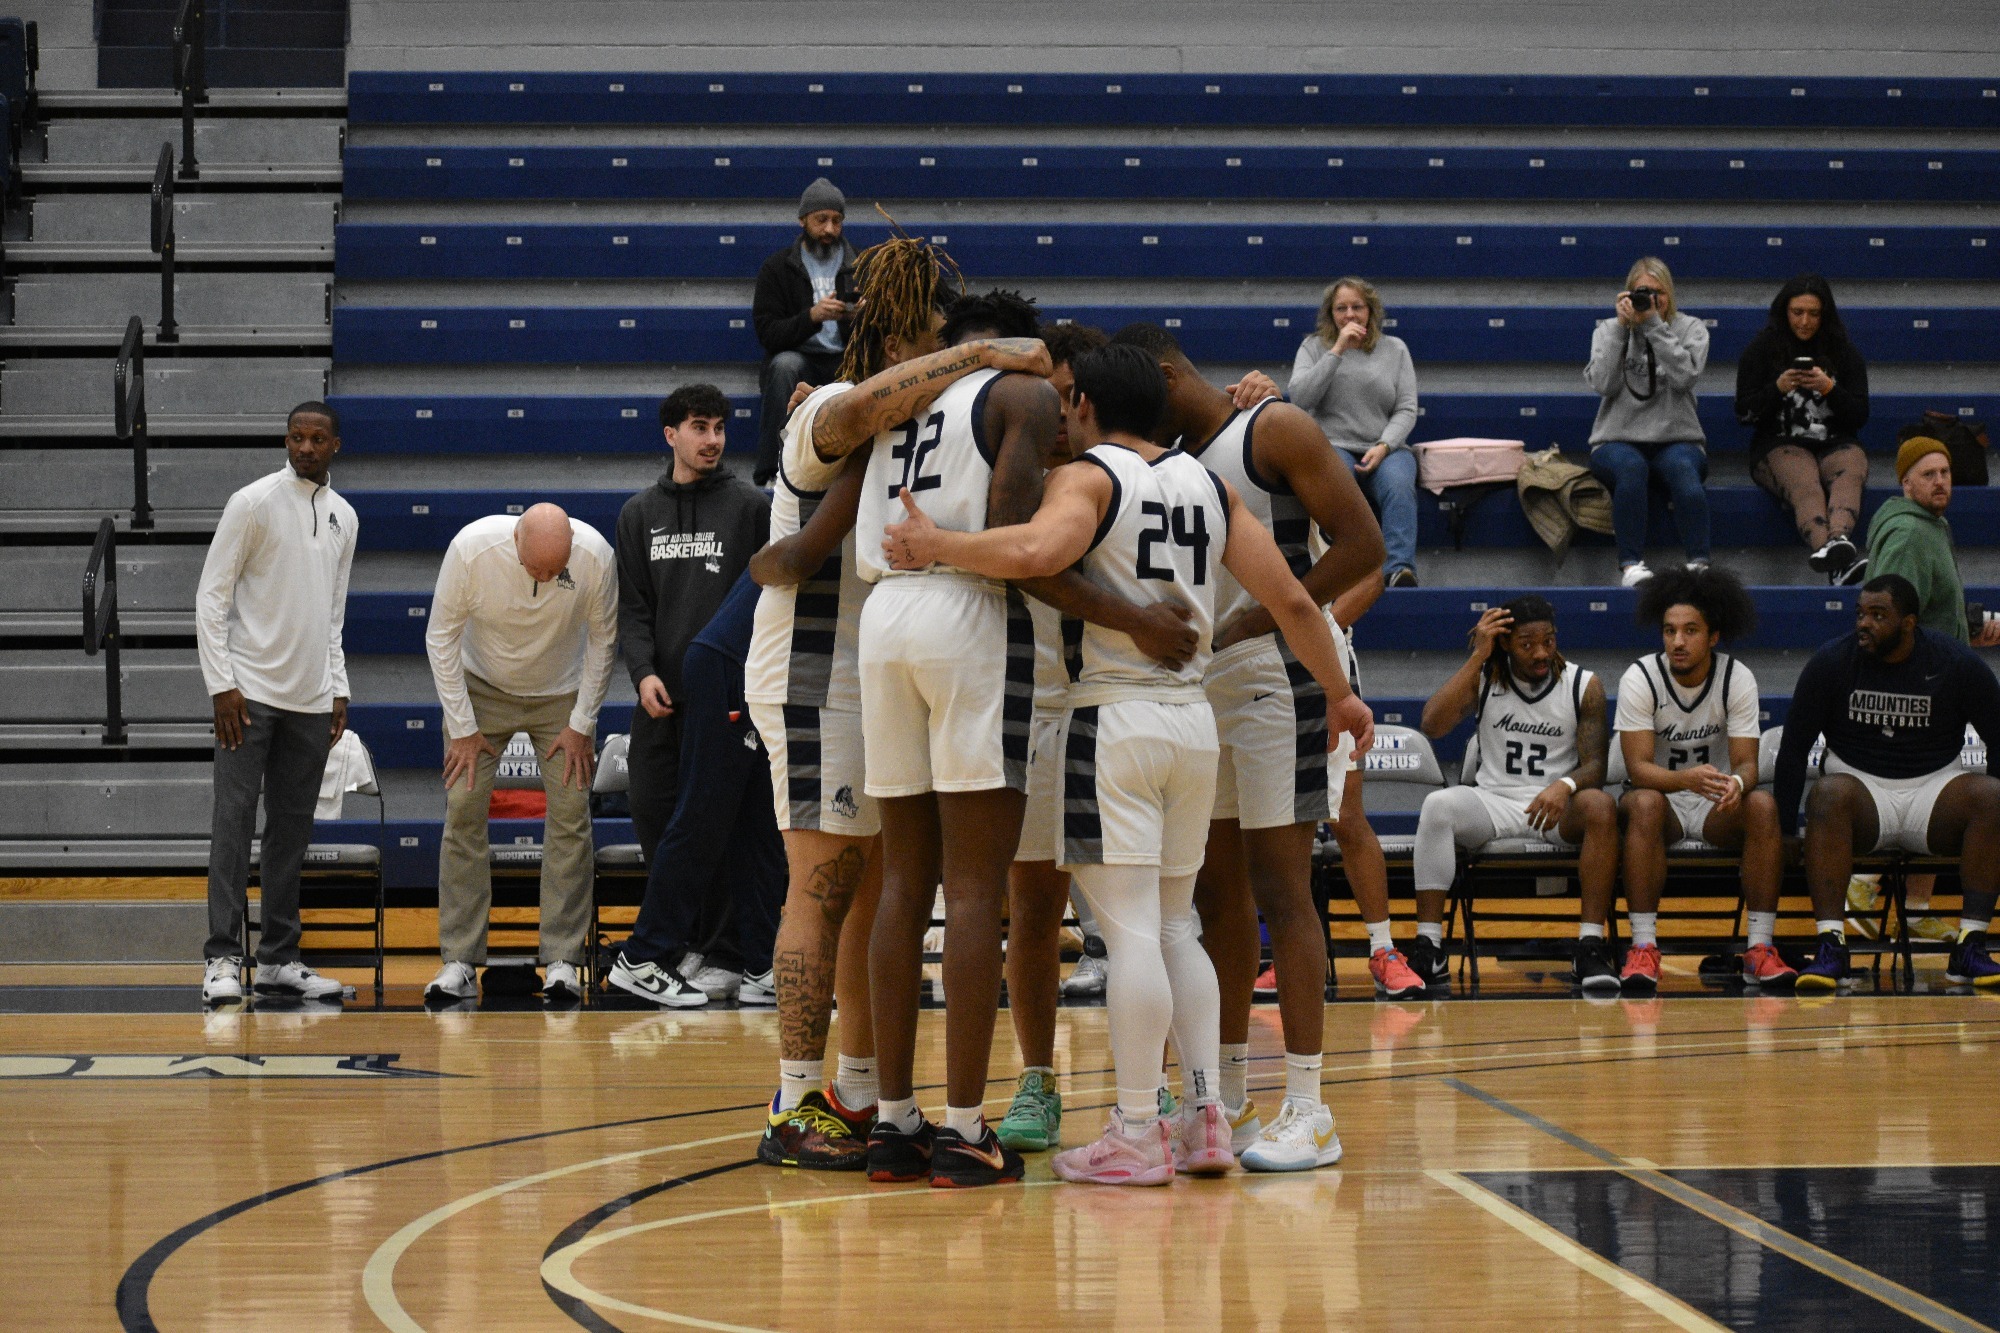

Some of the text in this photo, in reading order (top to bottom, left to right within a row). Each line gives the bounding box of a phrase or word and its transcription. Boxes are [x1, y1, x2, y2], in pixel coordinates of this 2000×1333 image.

[898, 375, 919, 390] XVI
[888, 410, 945, 499] 32
[651, 541, 724, 561] BASKETBALL
[1136, 500, 1210, 585] 24
[1851, 691, 1929, 715] MOUNTIES
[1493, 713, 1564, 737] Mounties
[1848, 709, 1930, 728] BASKETBALL
[1656, 723, 1721, 741] Mounties
[1506, 741, 1547, 776] 22
